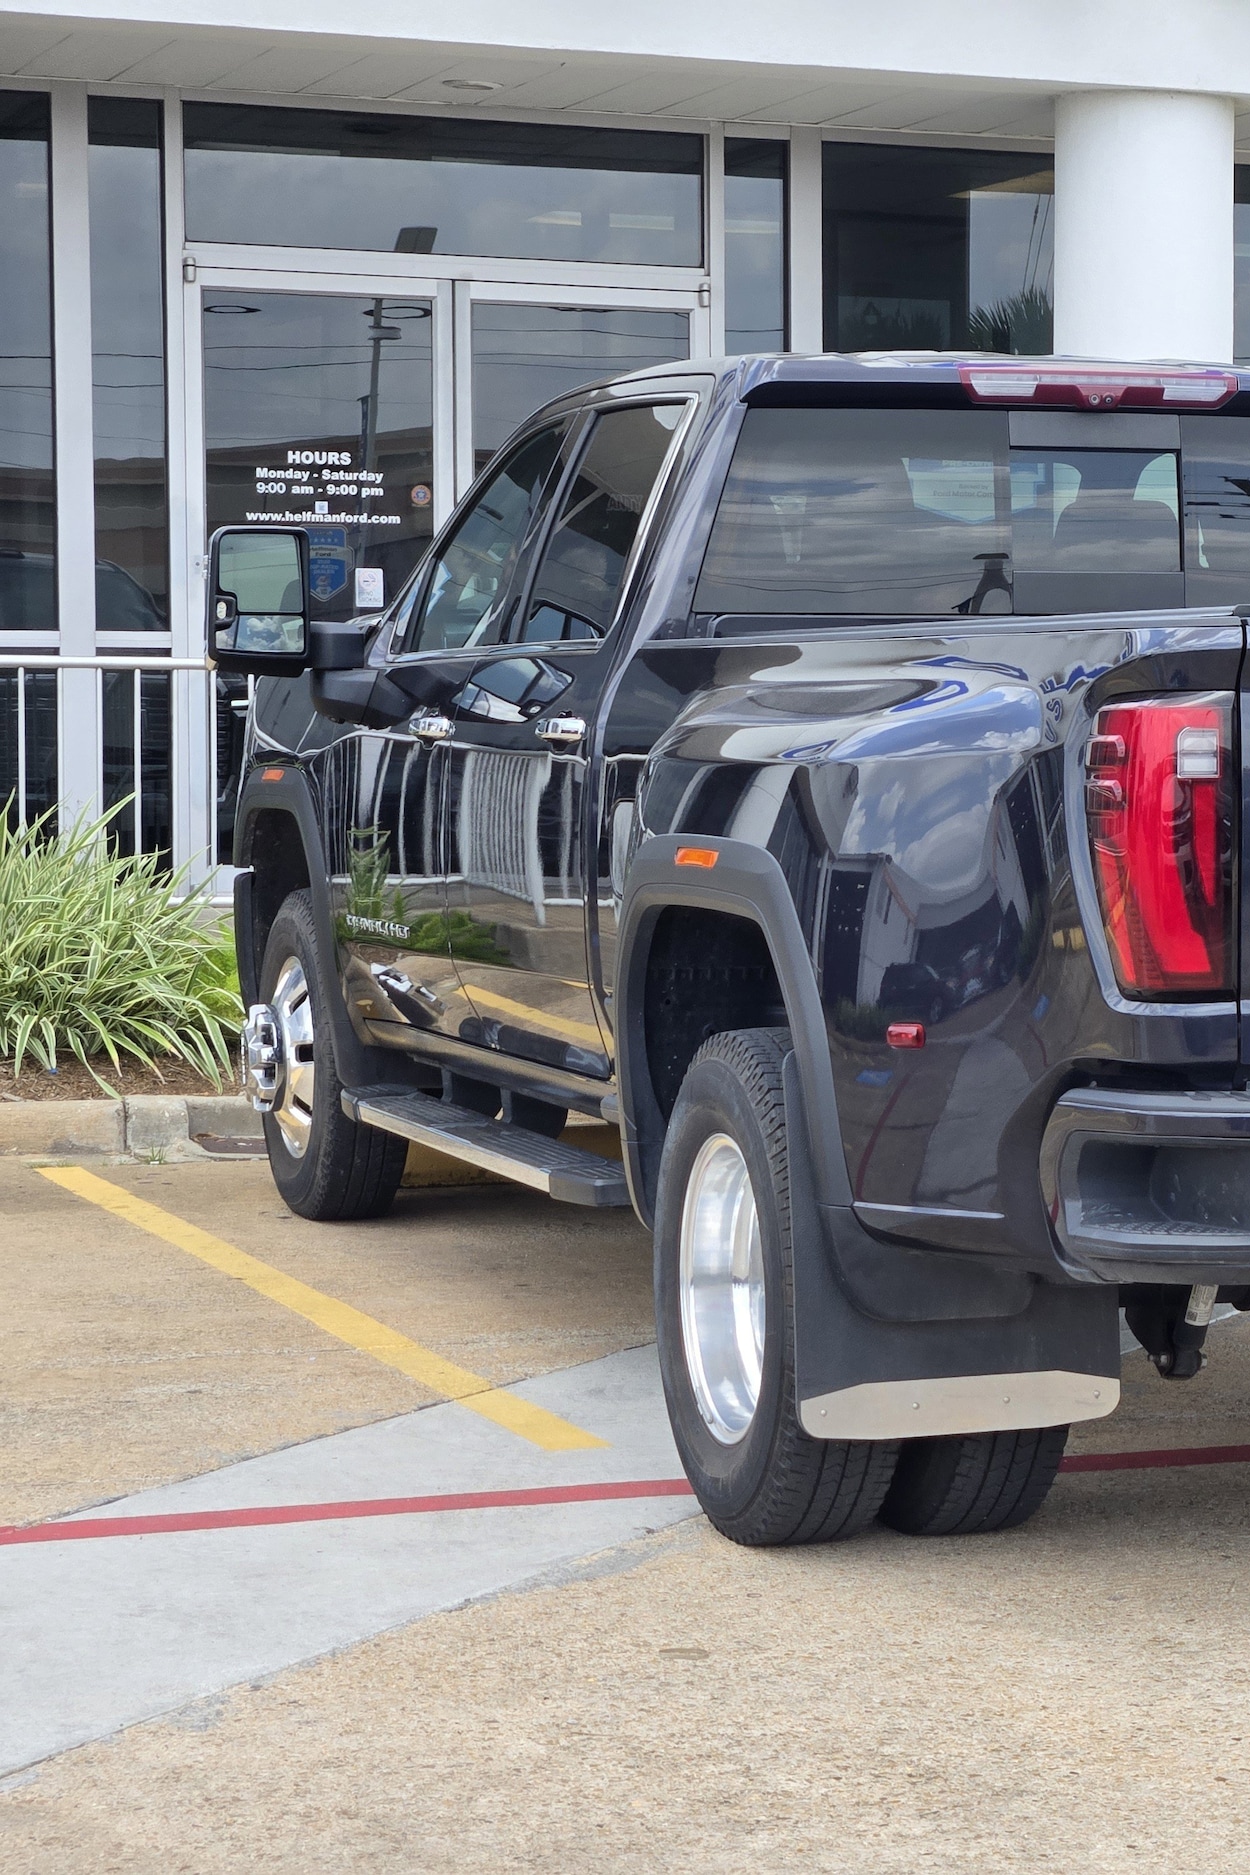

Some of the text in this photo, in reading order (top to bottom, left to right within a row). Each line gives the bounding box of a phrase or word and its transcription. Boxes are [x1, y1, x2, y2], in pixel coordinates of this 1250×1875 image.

[287, 451, 352, 466] HOURS
[255, 467, 310, 481] Monday
[321, 469, 384, 484] Saturday
[256, 482, 286, 494] 9:00
[291, 485, 314, 495] am
[326, 484, 358, 496] 9:00
[361, 487, 384, 498] pm
[246, 511, 401, 524] www.helfmanford.com
